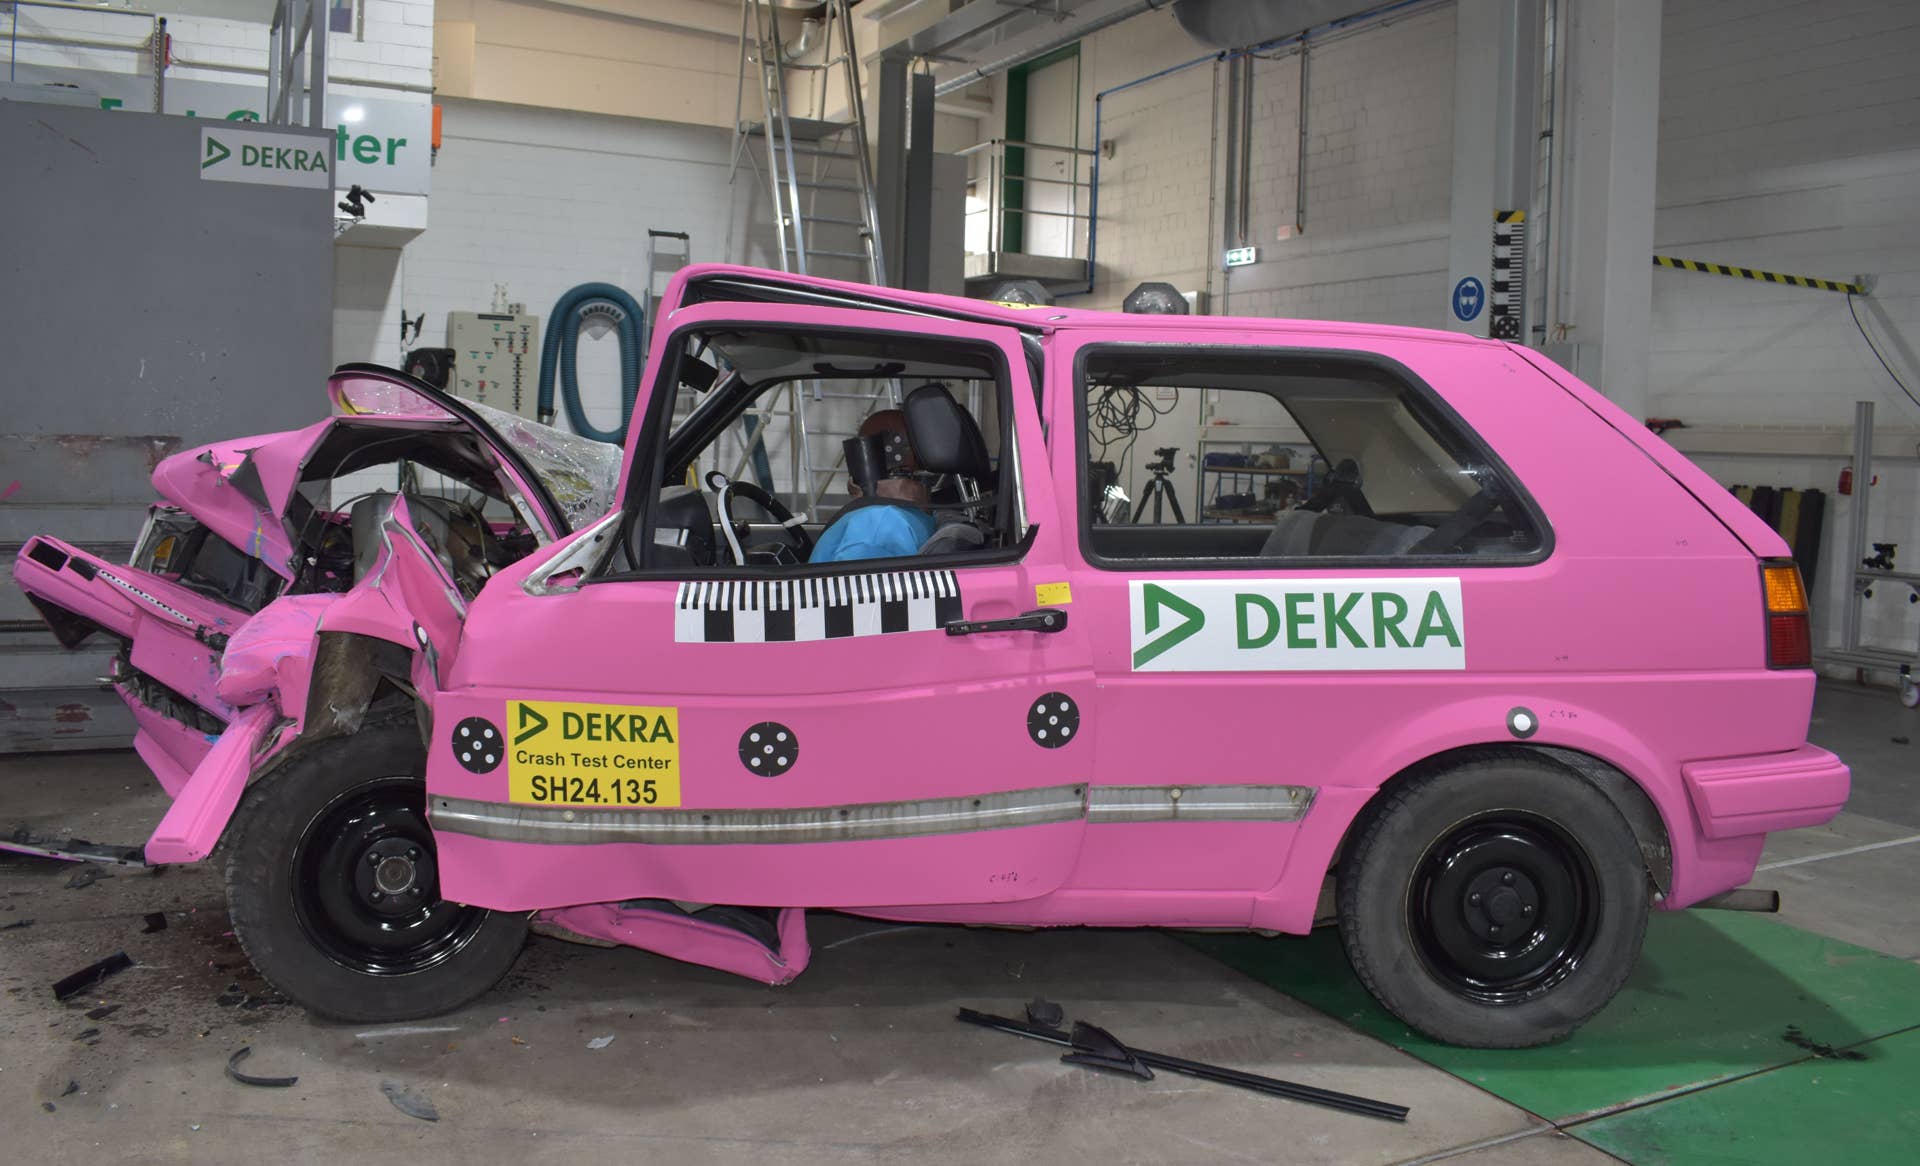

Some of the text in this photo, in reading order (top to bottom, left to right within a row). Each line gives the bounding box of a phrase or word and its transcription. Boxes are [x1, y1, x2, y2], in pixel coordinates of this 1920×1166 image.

[242, 144, 328, 173] DEKRA
[1235, 590, 1463, 650] DEKRA
[563, 712, 675, 744] DEKRA
[516, 750, 672, 770] Crash Test Center
[531, 775, 658, 805] SH24.135
